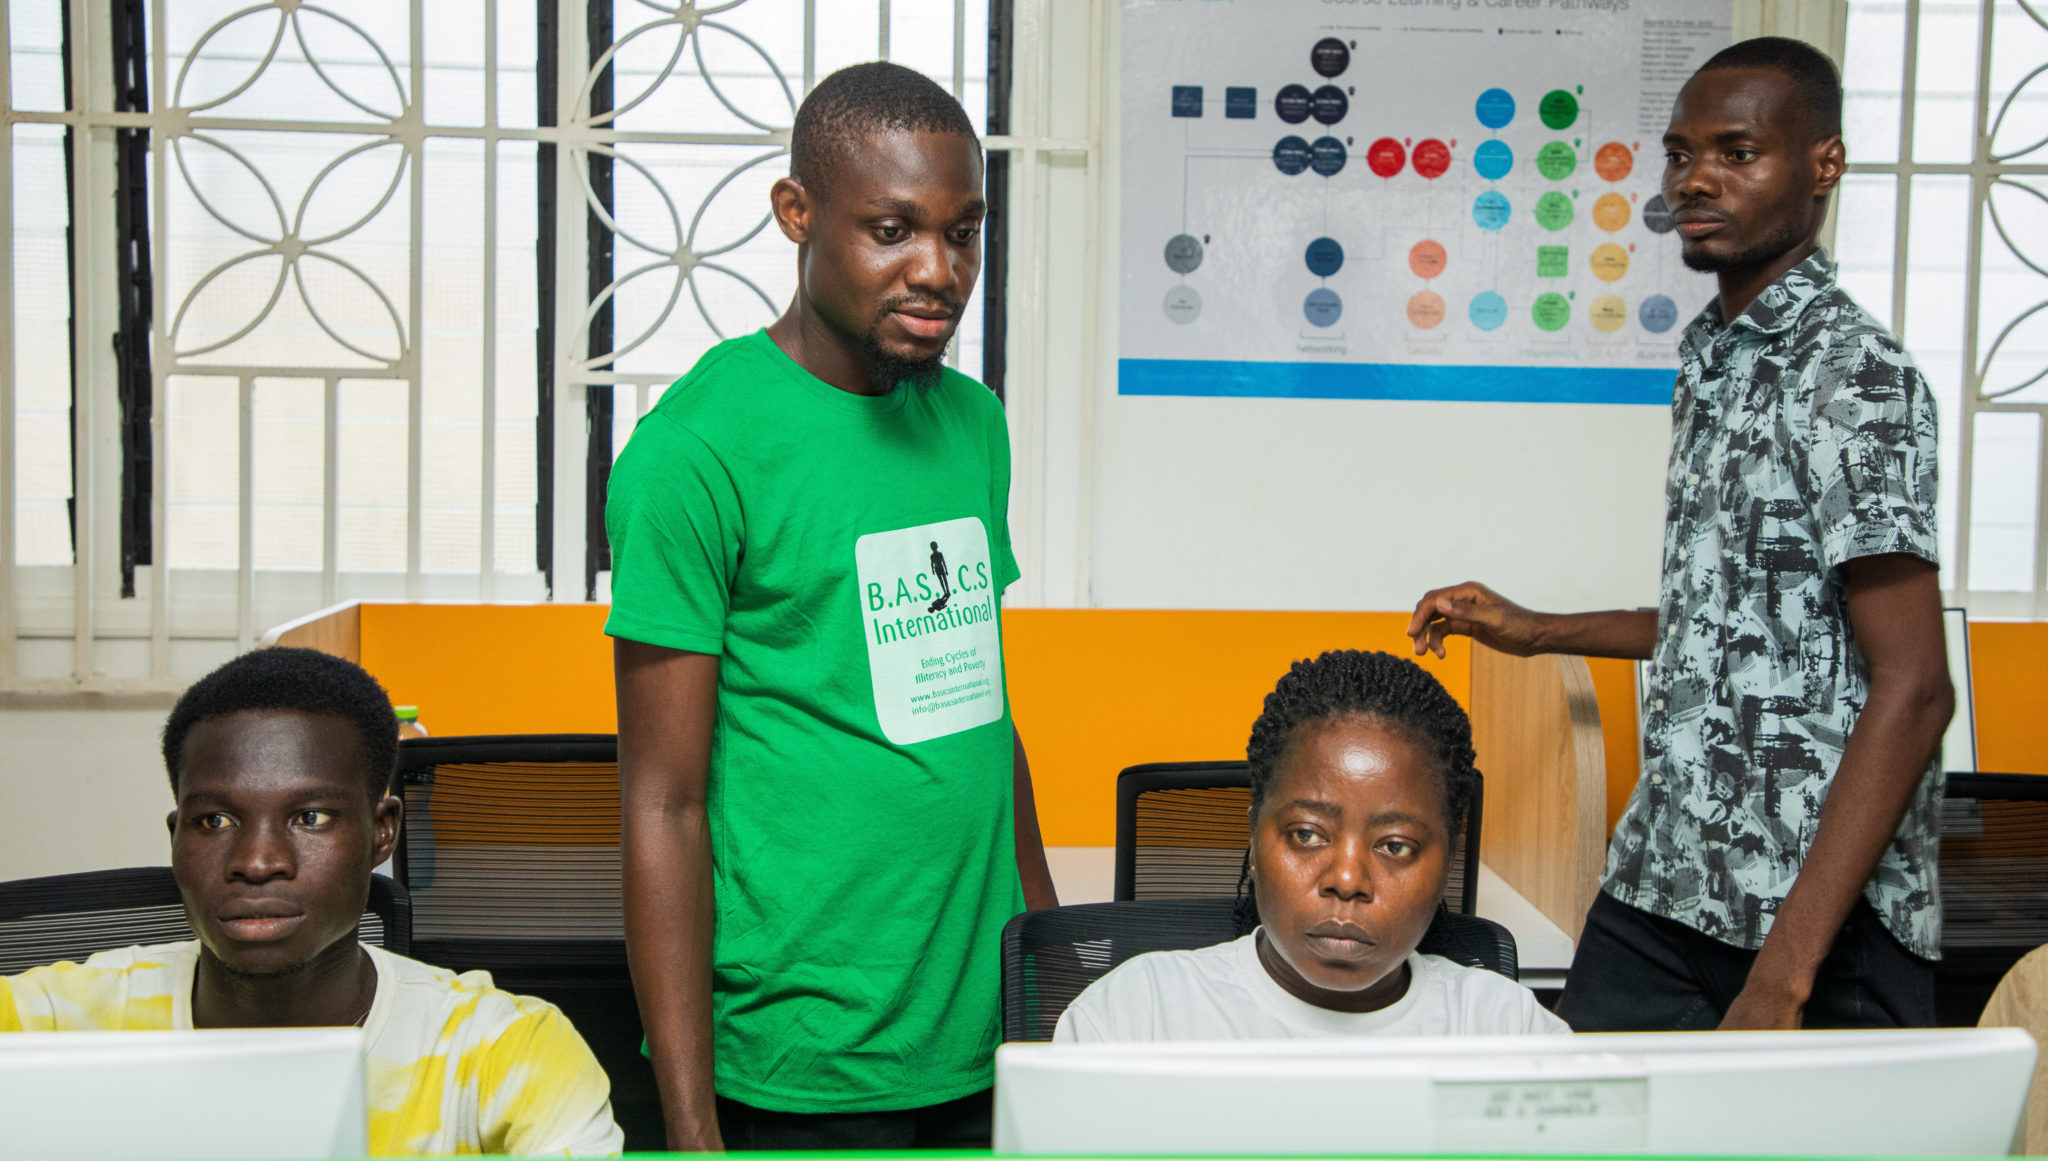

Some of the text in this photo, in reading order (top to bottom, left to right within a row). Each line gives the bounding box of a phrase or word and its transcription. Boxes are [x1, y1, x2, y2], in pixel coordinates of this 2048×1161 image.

[874, 595, 992, 645] International
[920, 645, 977, 669] Ending Cycles of
[915, 659, 986, 684] Illiteracy and Poverty
